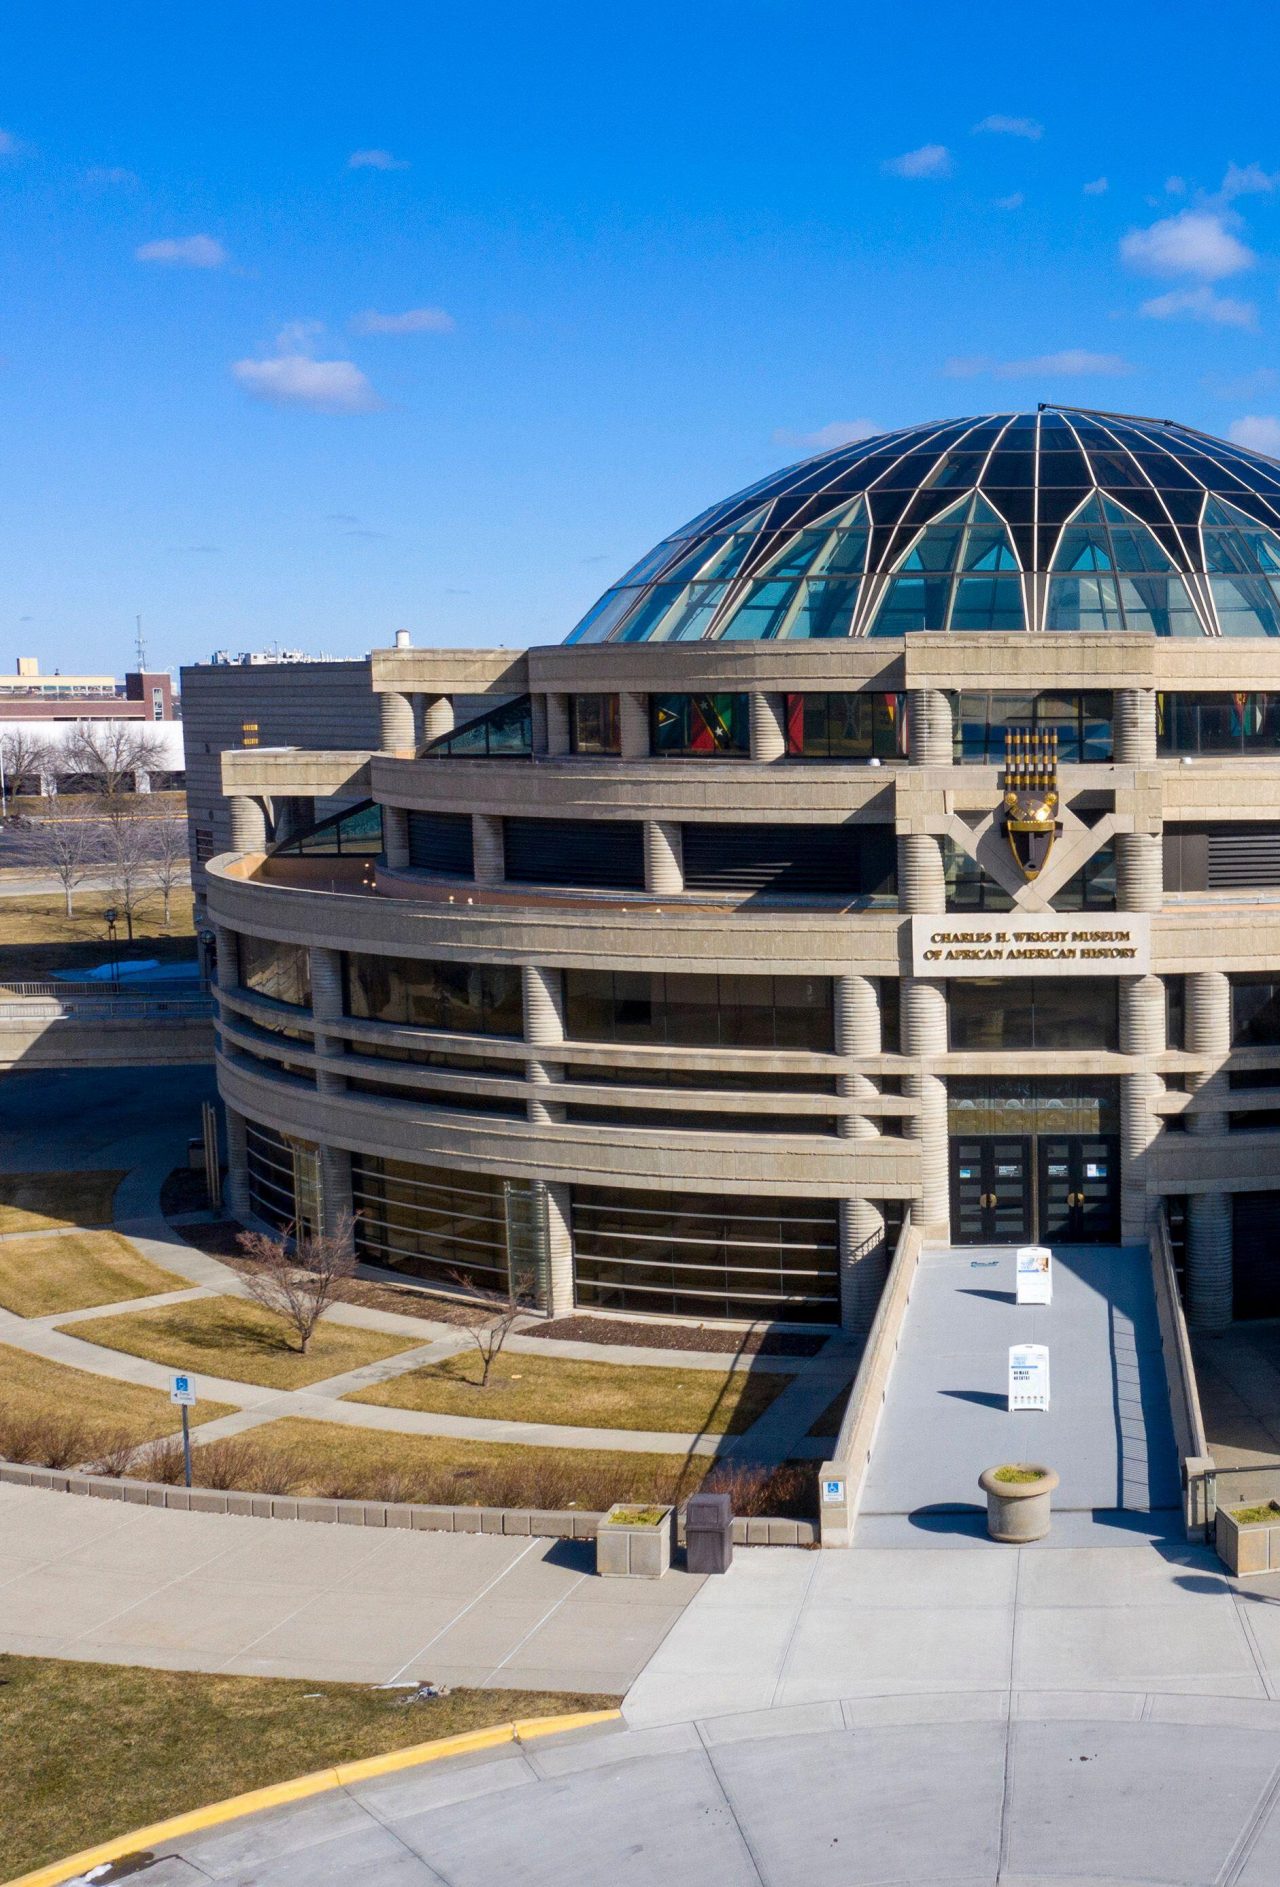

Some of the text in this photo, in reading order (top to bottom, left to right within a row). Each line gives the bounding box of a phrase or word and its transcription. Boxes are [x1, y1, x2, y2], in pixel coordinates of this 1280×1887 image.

[930, 931, 1130, 944] CHARLES H. WRIGHT MUSEUM
[922, 947, 1138, 961] OF AFRICAN AMERICAN HISTORY
